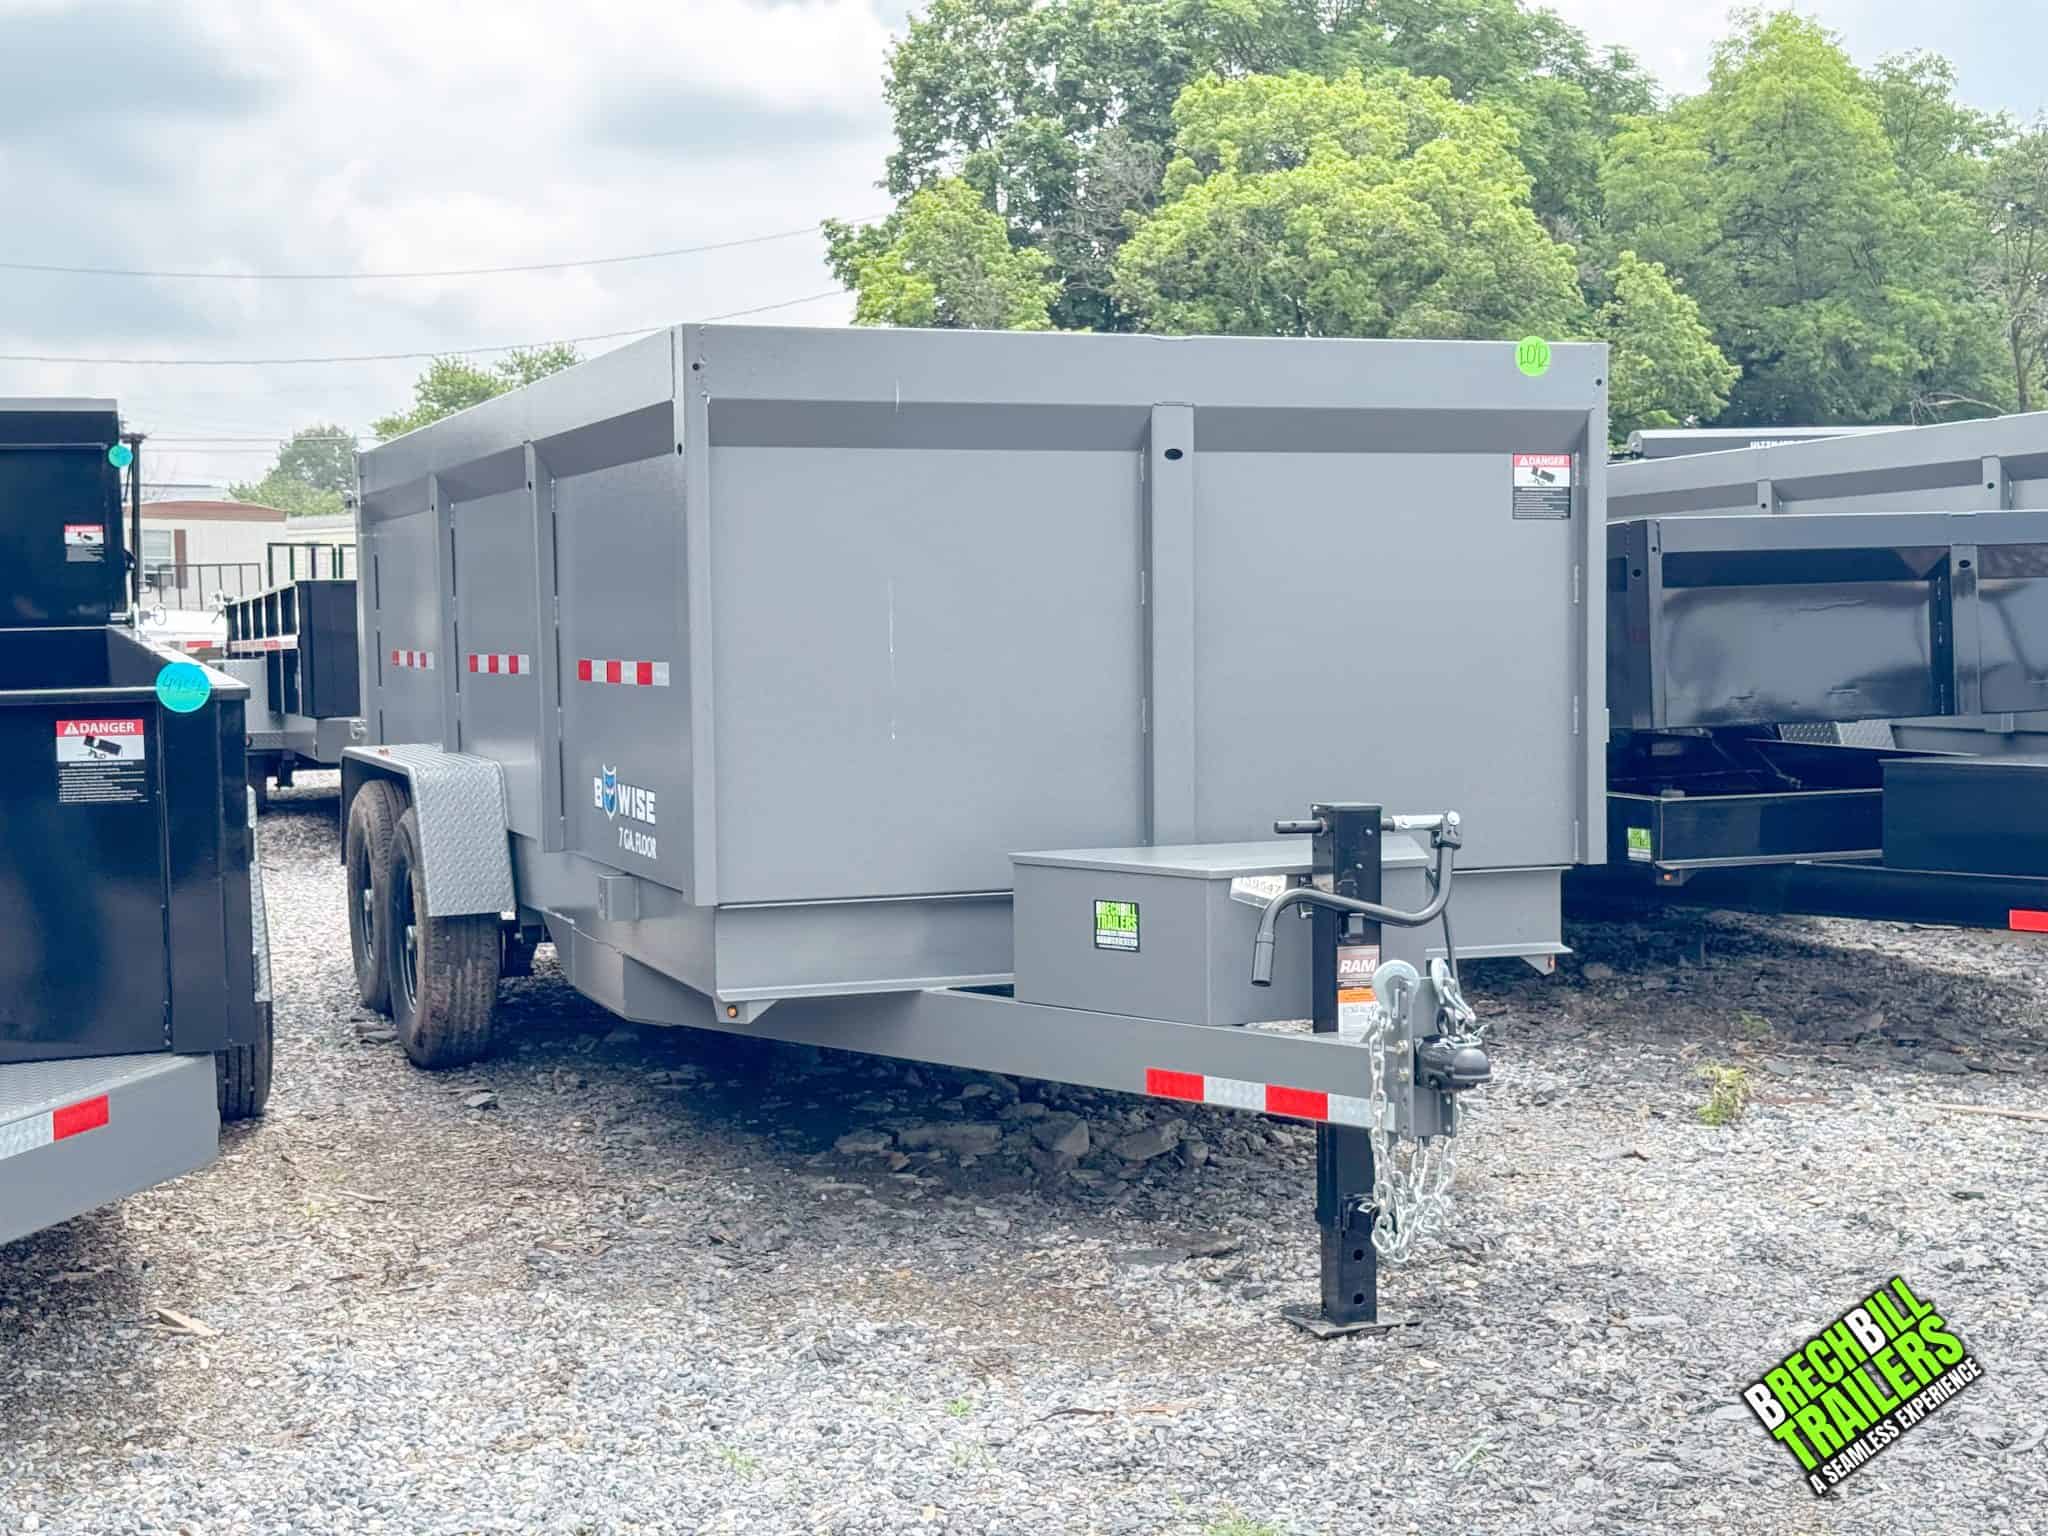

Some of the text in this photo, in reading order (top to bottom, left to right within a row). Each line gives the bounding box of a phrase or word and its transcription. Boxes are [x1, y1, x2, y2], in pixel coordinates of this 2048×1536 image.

[1529, 455, 1565, 466] DANGER
[80, 722, 135, 734] DANGER
[1097, 914, 1138, 932] TRAILERS
[1340, 959, 1377, 973] RAM
